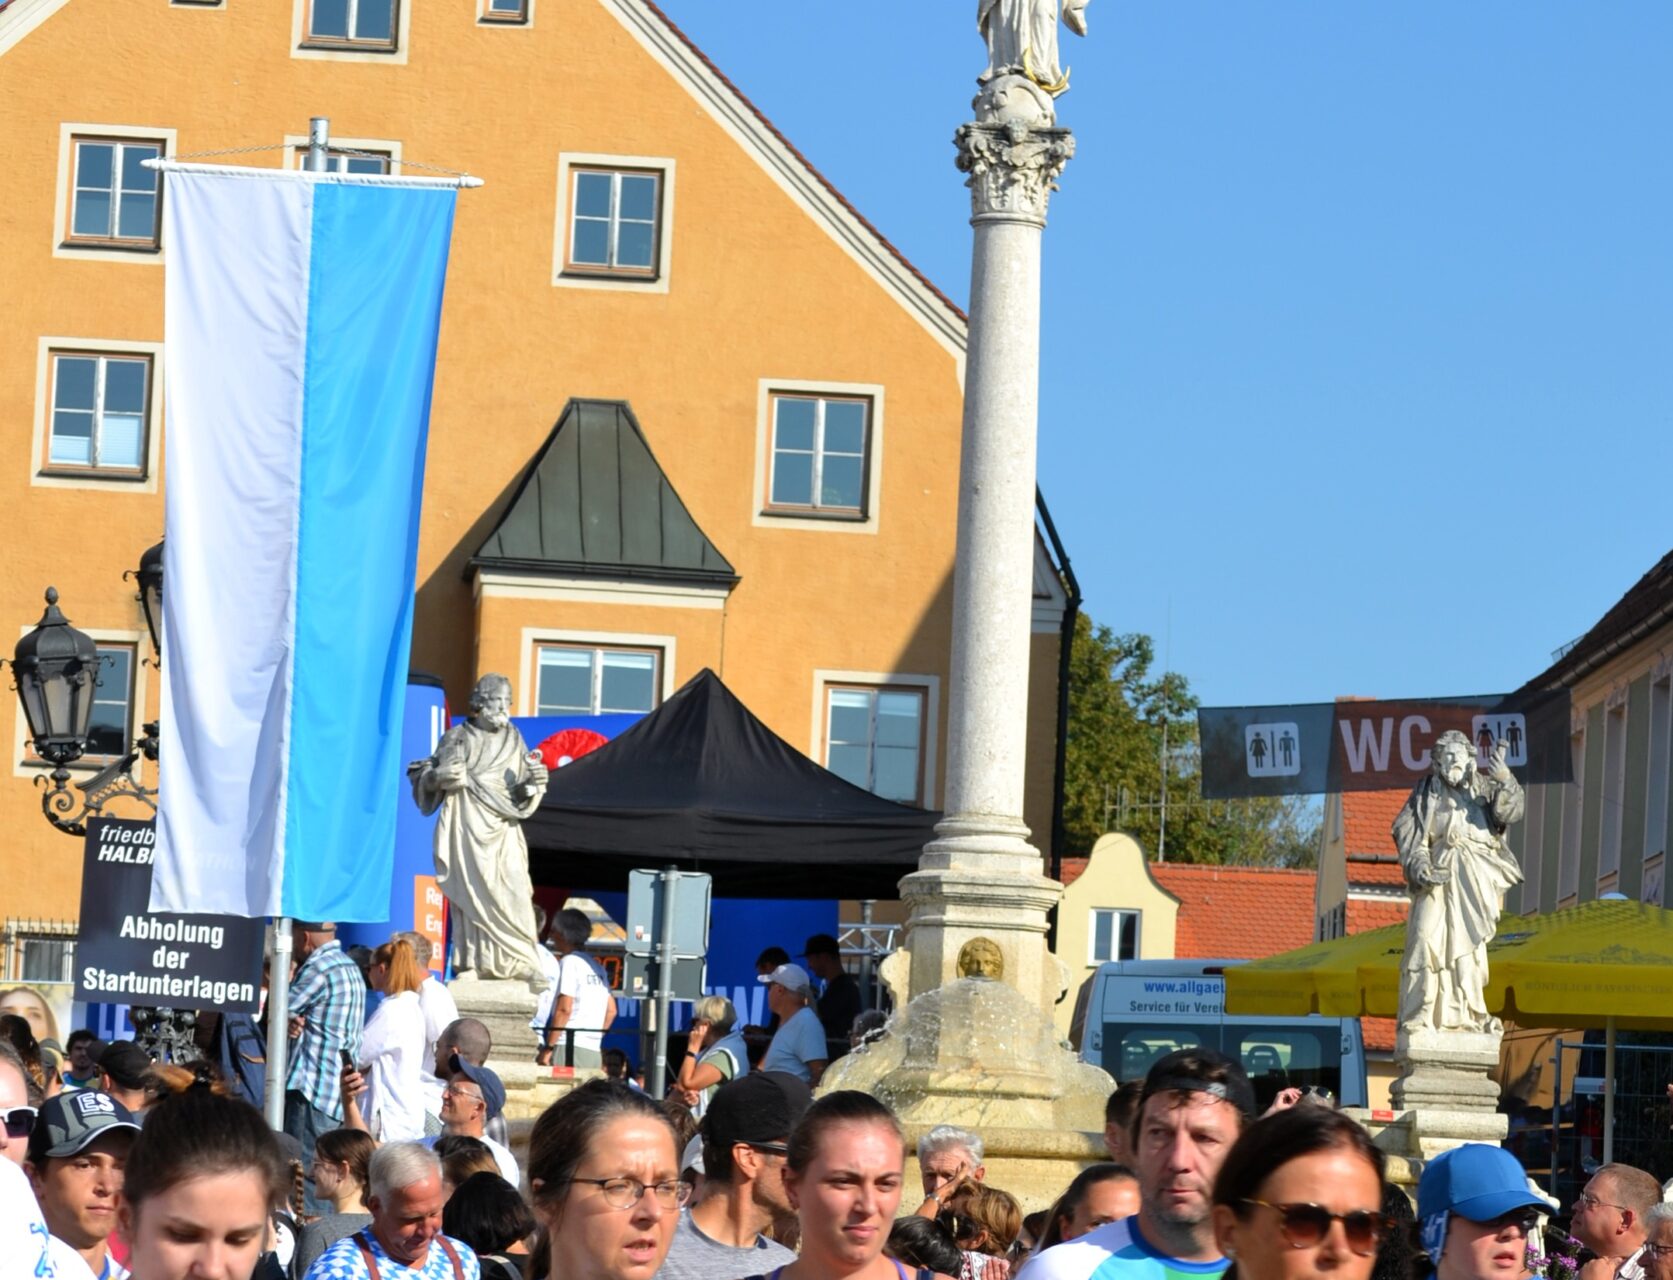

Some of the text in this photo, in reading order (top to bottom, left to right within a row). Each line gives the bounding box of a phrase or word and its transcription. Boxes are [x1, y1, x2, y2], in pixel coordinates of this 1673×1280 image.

[1339, 715, 1432, 773] WC
[119, 915, 224, 949] Abholung
[152, 945, 189, 969] der
[82, 967, 254, 1004] Startunterlagen
[1130, 1000, 1170, 1013] Service
[1175, 1001, 1190, 1013] für
[76, 1092, 115, 1112] ES
